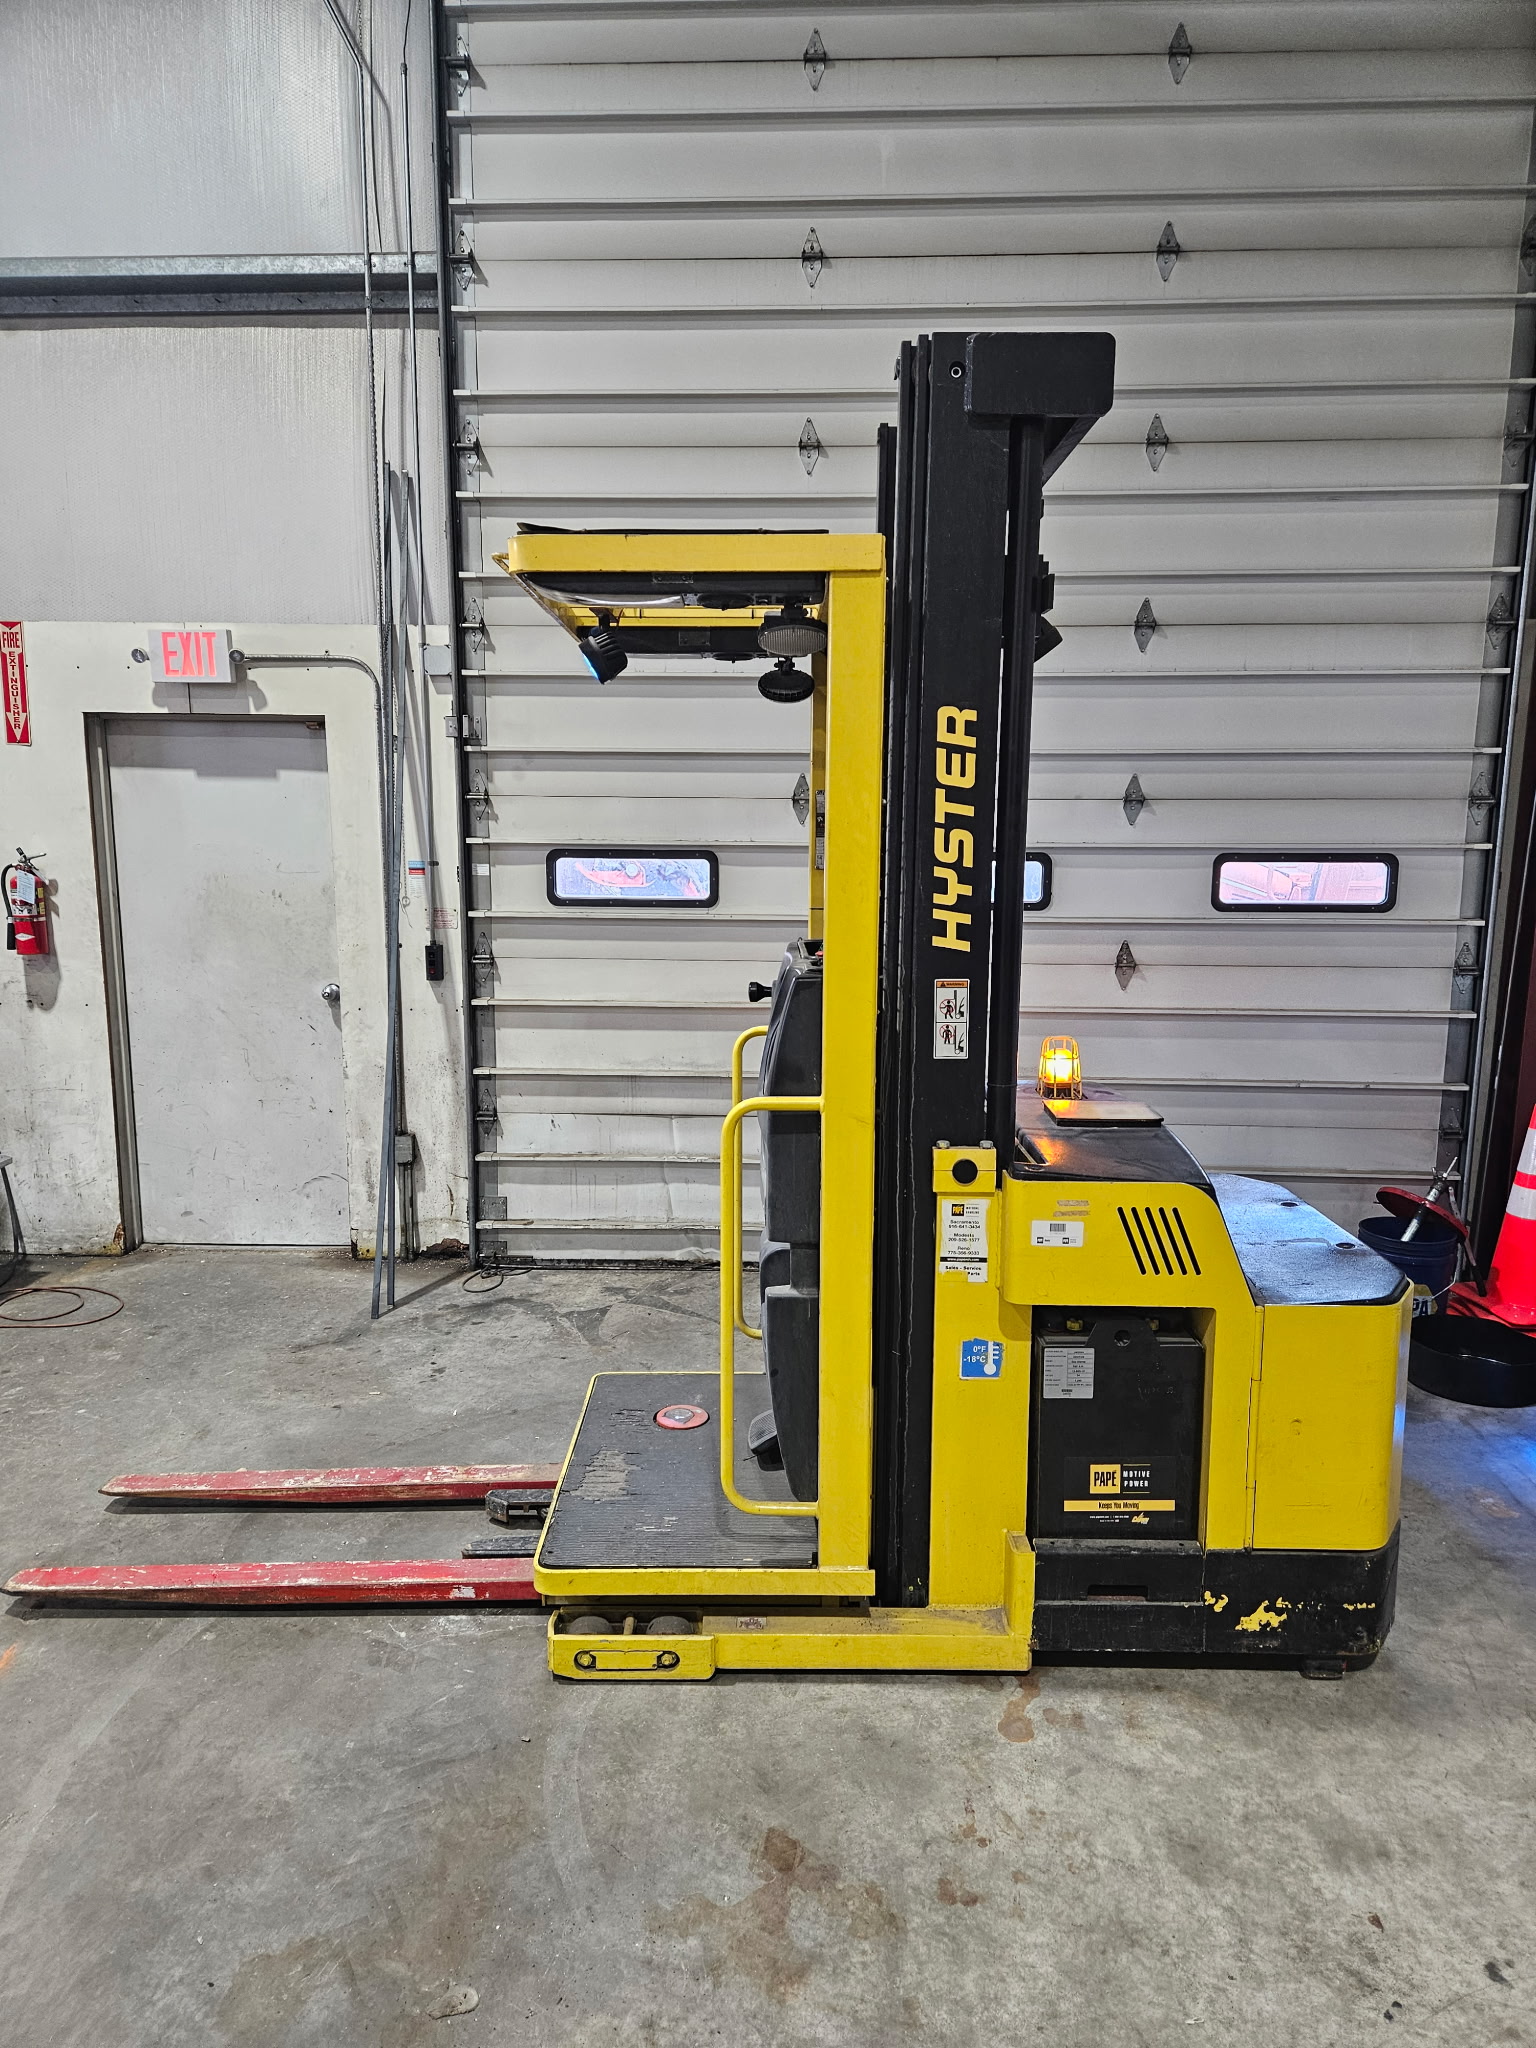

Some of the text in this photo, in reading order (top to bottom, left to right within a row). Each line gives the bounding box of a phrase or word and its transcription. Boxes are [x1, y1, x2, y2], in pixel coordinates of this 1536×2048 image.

[2, 631, 20, 649] FIRE
[161, 631, 217, 677] EXIT
[8, 651, 21, 729] EXTINGUISHER
[931, 705, 978, 953] HYSTER
[963, 1355, 986, 1363] -18°C
[1123, 1470, 1150, 1478] MOTIVE
[1099, 1502, 1112, 1510] Keeps
[1123, 1502, 1139, 1510] Moving
